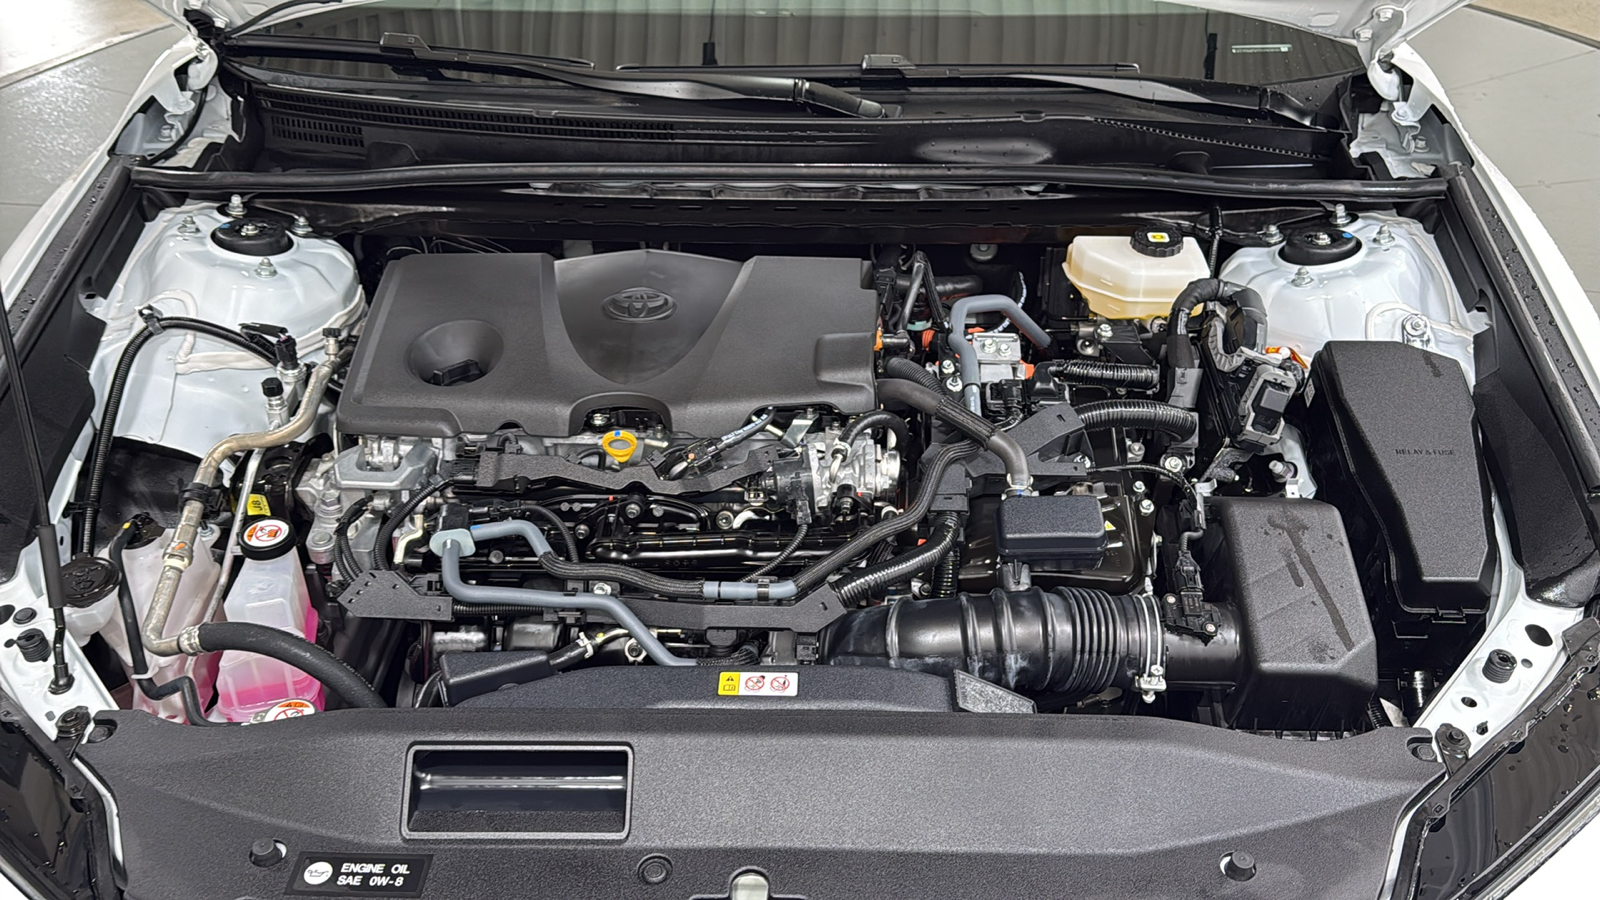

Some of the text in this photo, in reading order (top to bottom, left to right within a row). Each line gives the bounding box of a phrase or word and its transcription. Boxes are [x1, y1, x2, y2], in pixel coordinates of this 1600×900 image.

[1395, 448, 1424, 456] RELAY
[340, 862, 411, 875] ENGINE OIL
[336, 875, 404, 887] SAE 0W-8
